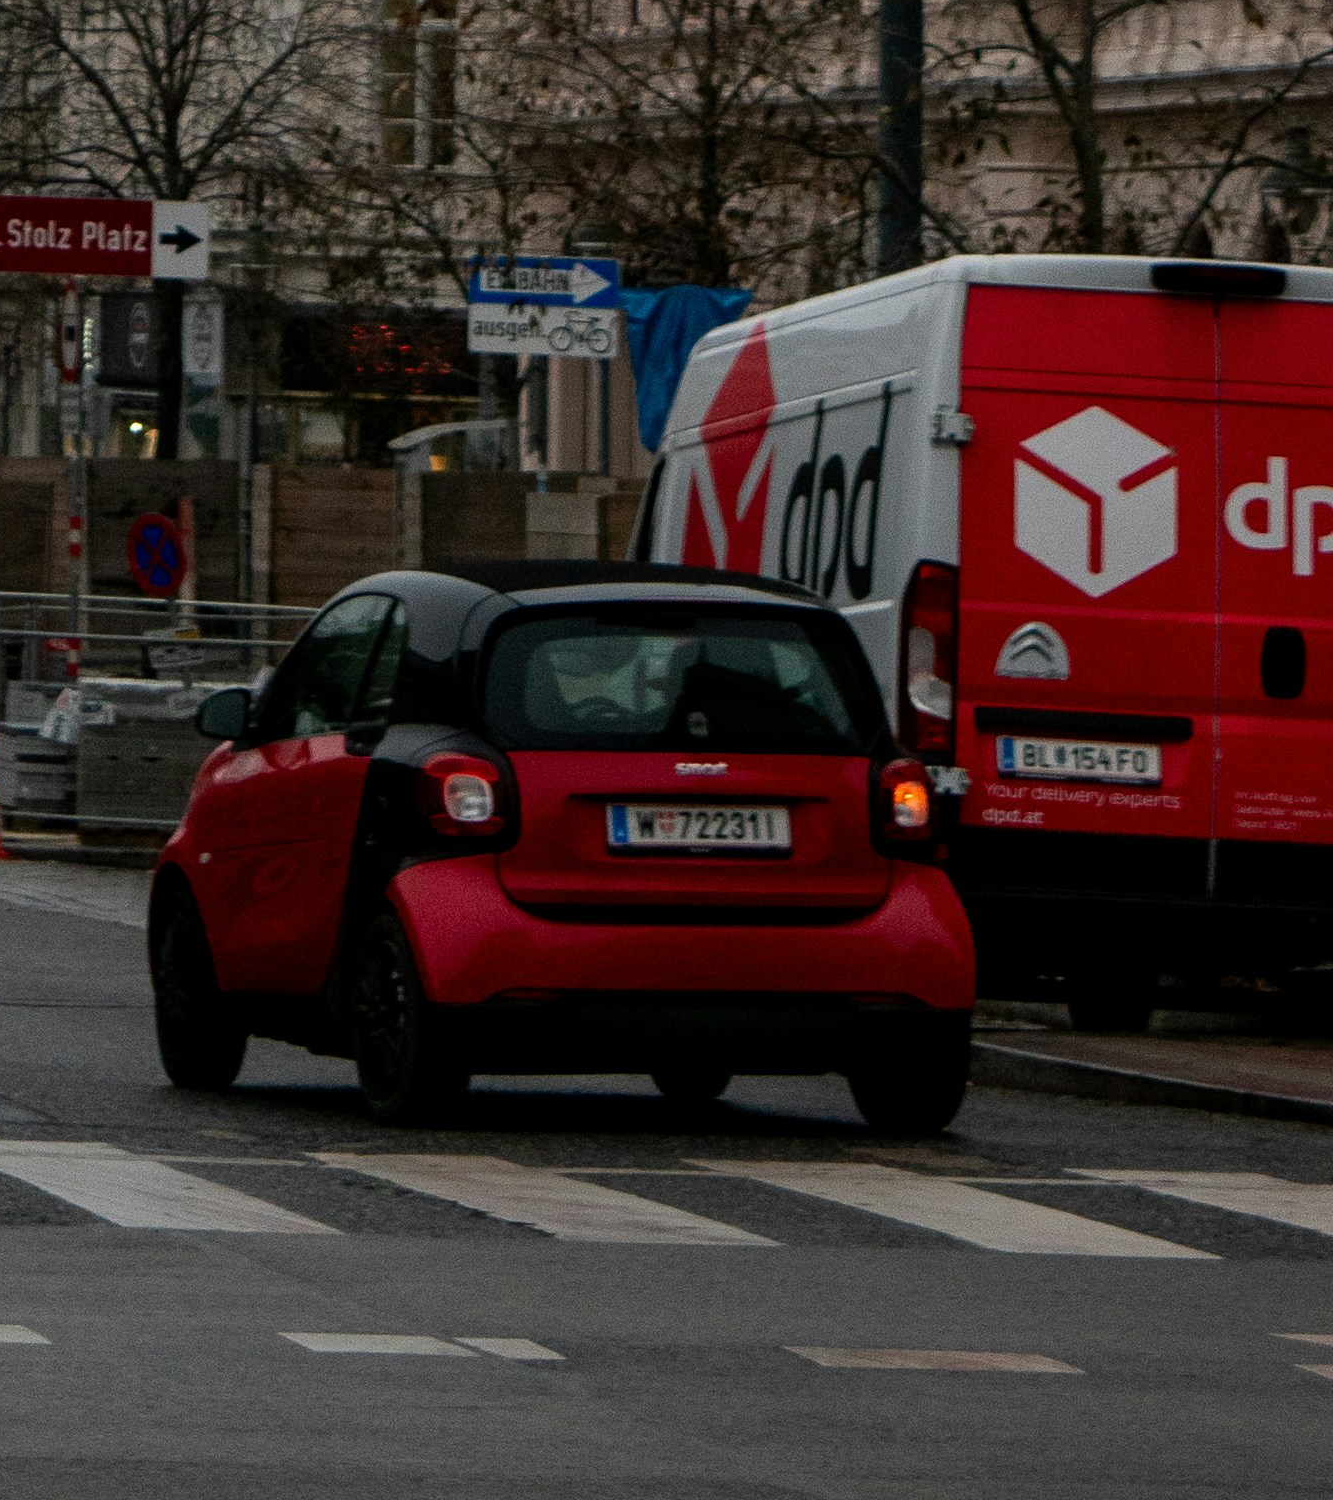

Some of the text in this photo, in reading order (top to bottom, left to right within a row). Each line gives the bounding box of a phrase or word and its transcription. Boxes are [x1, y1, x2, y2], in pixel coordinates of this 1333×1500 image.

[82, 221, 148, 253] Platz
[486, 267, 571, 292] EBAHN
[779, 381, 893, 600] dpd
[1022, 743, 1051, 768] BL
[1071, 746, 1112, 771] 154
[983, 782, 1183, 811] Your delivery experts
[636, 810, 655, 839] W
[981, 808, 1045, 825] dpd.at
